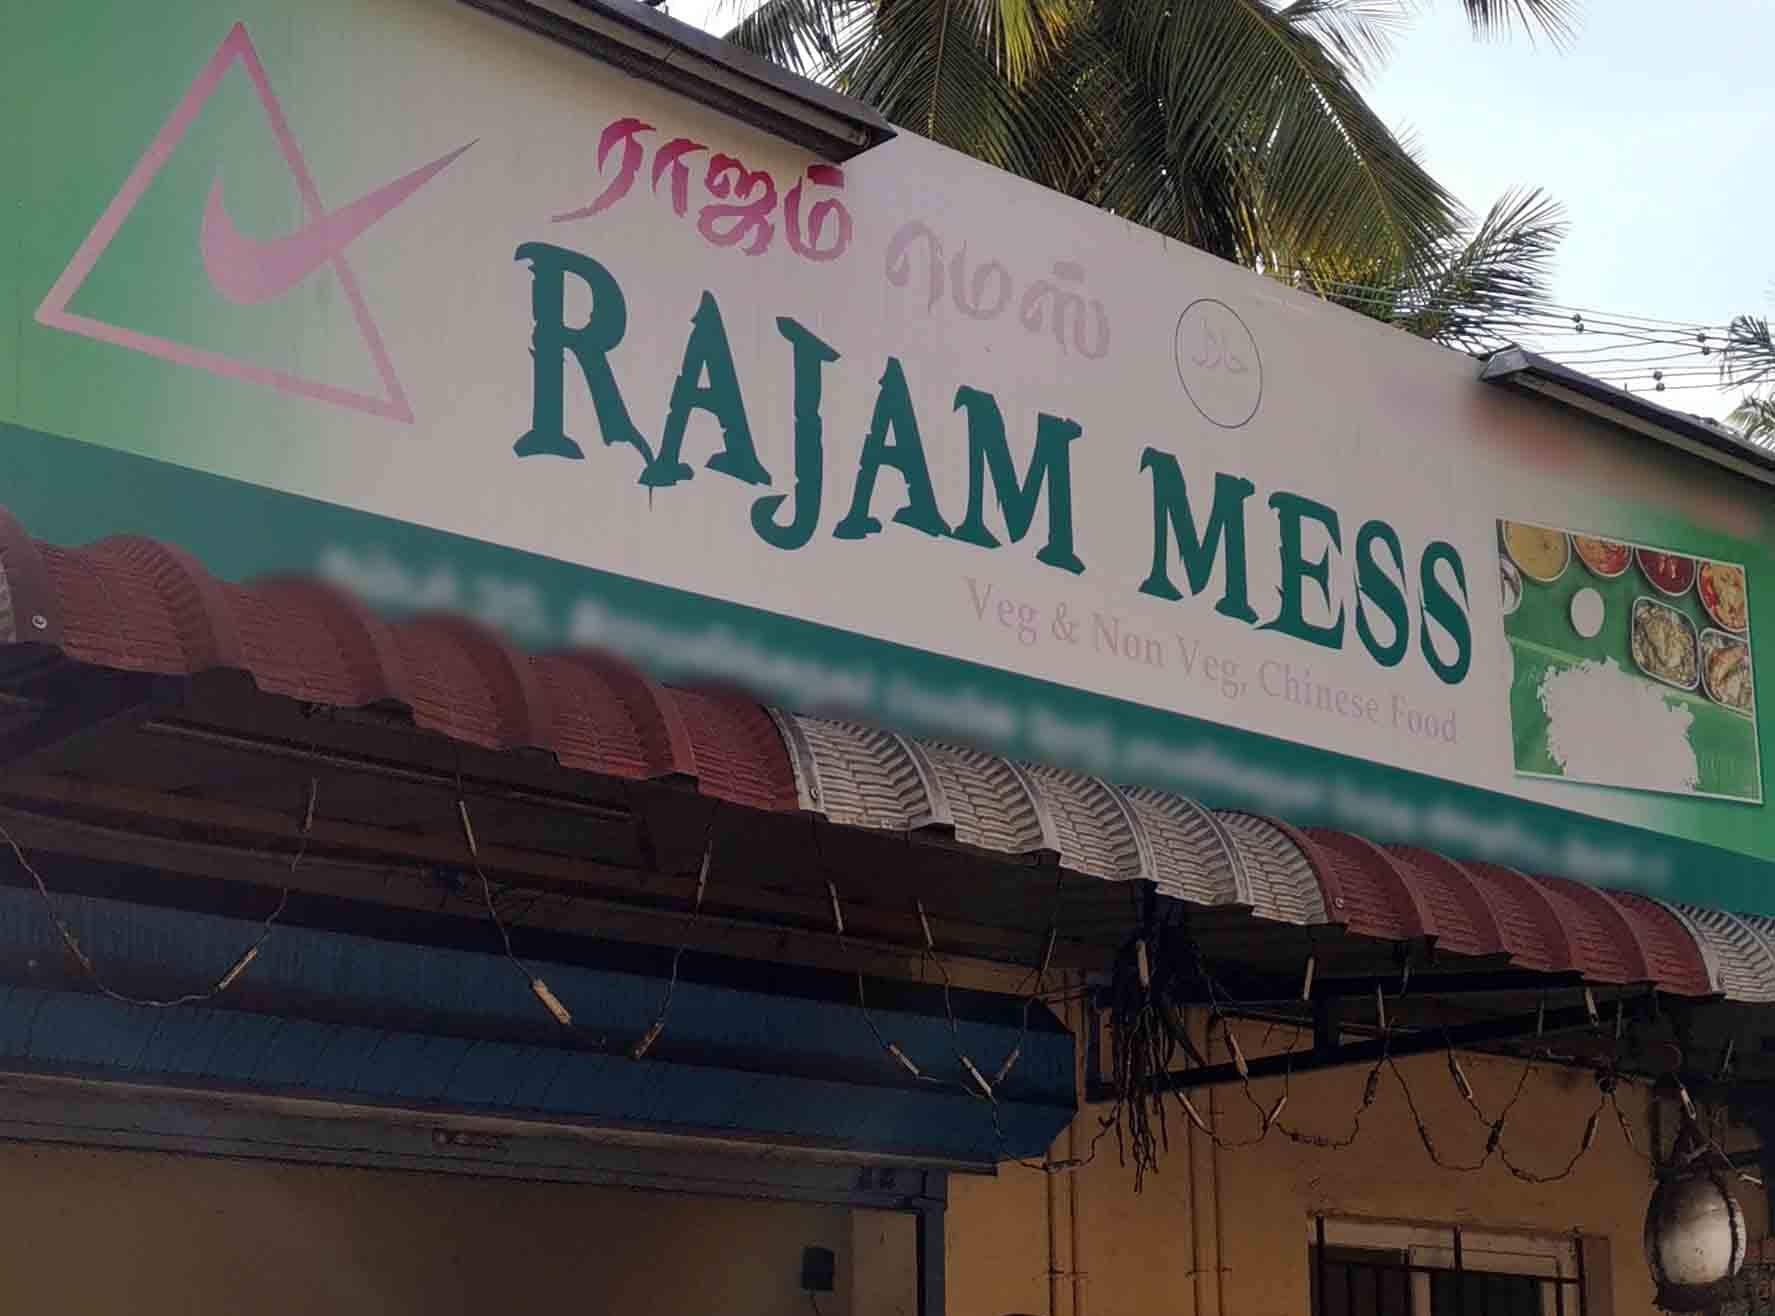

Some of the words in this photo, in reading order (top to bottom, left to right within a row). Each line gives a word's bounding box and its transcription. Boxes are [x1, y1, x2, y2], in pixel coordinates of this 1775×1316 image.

[551, 115, 853, 262] ராஜம்
[512, 241, 1087, 576] RAJAM
[1137, 446, 1473, 686] MESS
[964, 577, 1038, 646] Veg
[1051, 601, 1076, 645] &
[1091, 611, 1163, 668] Non
[1176, 633, 1247, 699] Veg,
[1258, 660, 1379, 723] Chinese
[1391, 693, 1458, 743] Food
